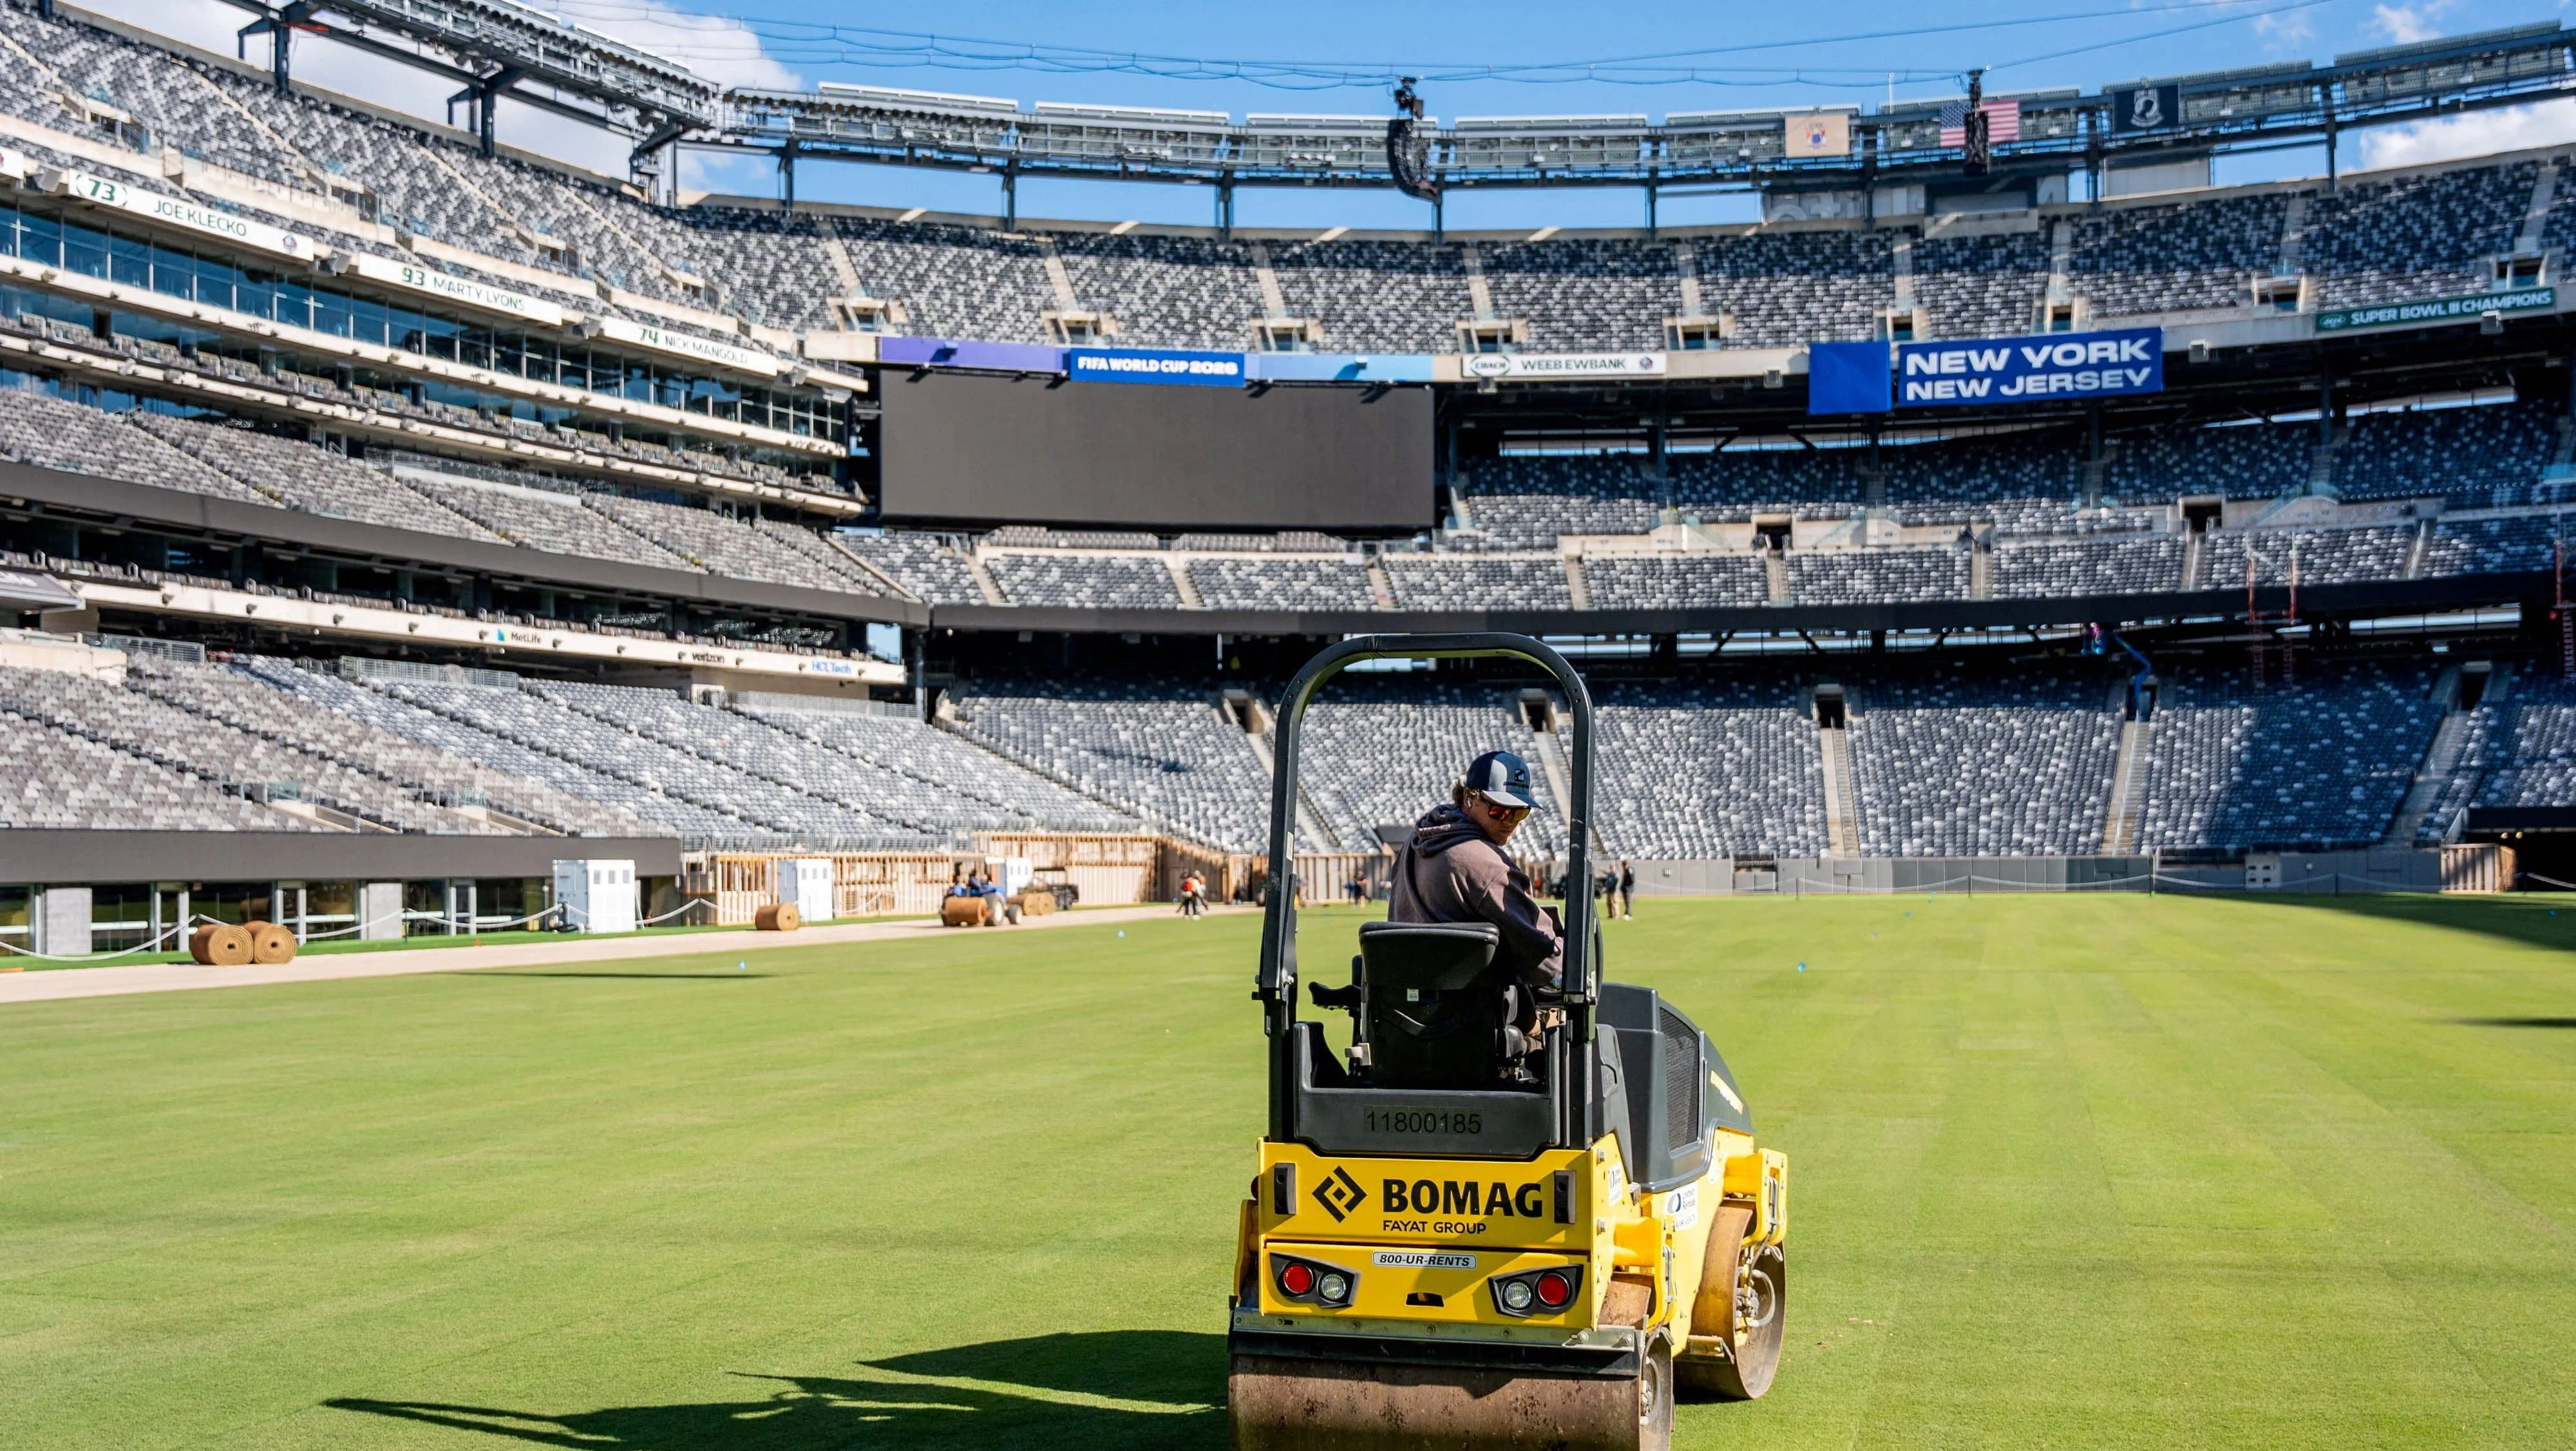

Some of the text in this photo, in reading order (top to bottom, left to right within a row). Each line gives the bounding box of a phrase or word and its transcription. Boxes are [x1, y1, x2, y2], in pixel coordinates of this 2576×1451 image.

[88, 178, 247, 236] 73 JOE KLECKO
[402, 267, 524, 311] 93 MARTY LYONS
[2351, 308, 2396, 325] SUPER
[2400, 303, 2445, 320] BOWL
[2448, 300, 2460, 314] III
[2461, 290, 2552, 312] CHAMPIONS
[639, 327, 748, 364] 74 NICK MANGOLD
[1906, 337, 2152, 375] NEW YORK
[1077, 356, 1238, 375] FIFA WORLD CUP 2026
[1521, 359, 1626, 370] WEEB EWBANK
[1906, 366, 2152, 401] NEW JERSEY
[511, 632, 542, 643] MetLife
[692, 651, 724, 663] verizon
[812, 660, 851, 674] HCLTech
[1367, 1111, 1481, 1134] 11800185
[1383, 1179, 1542, 1218] BOMAG
[1383, 1220, 1486, 1234] FAYAT GROUP
[1379, 1255, 1470, 1267] 800-UR-RENTS
